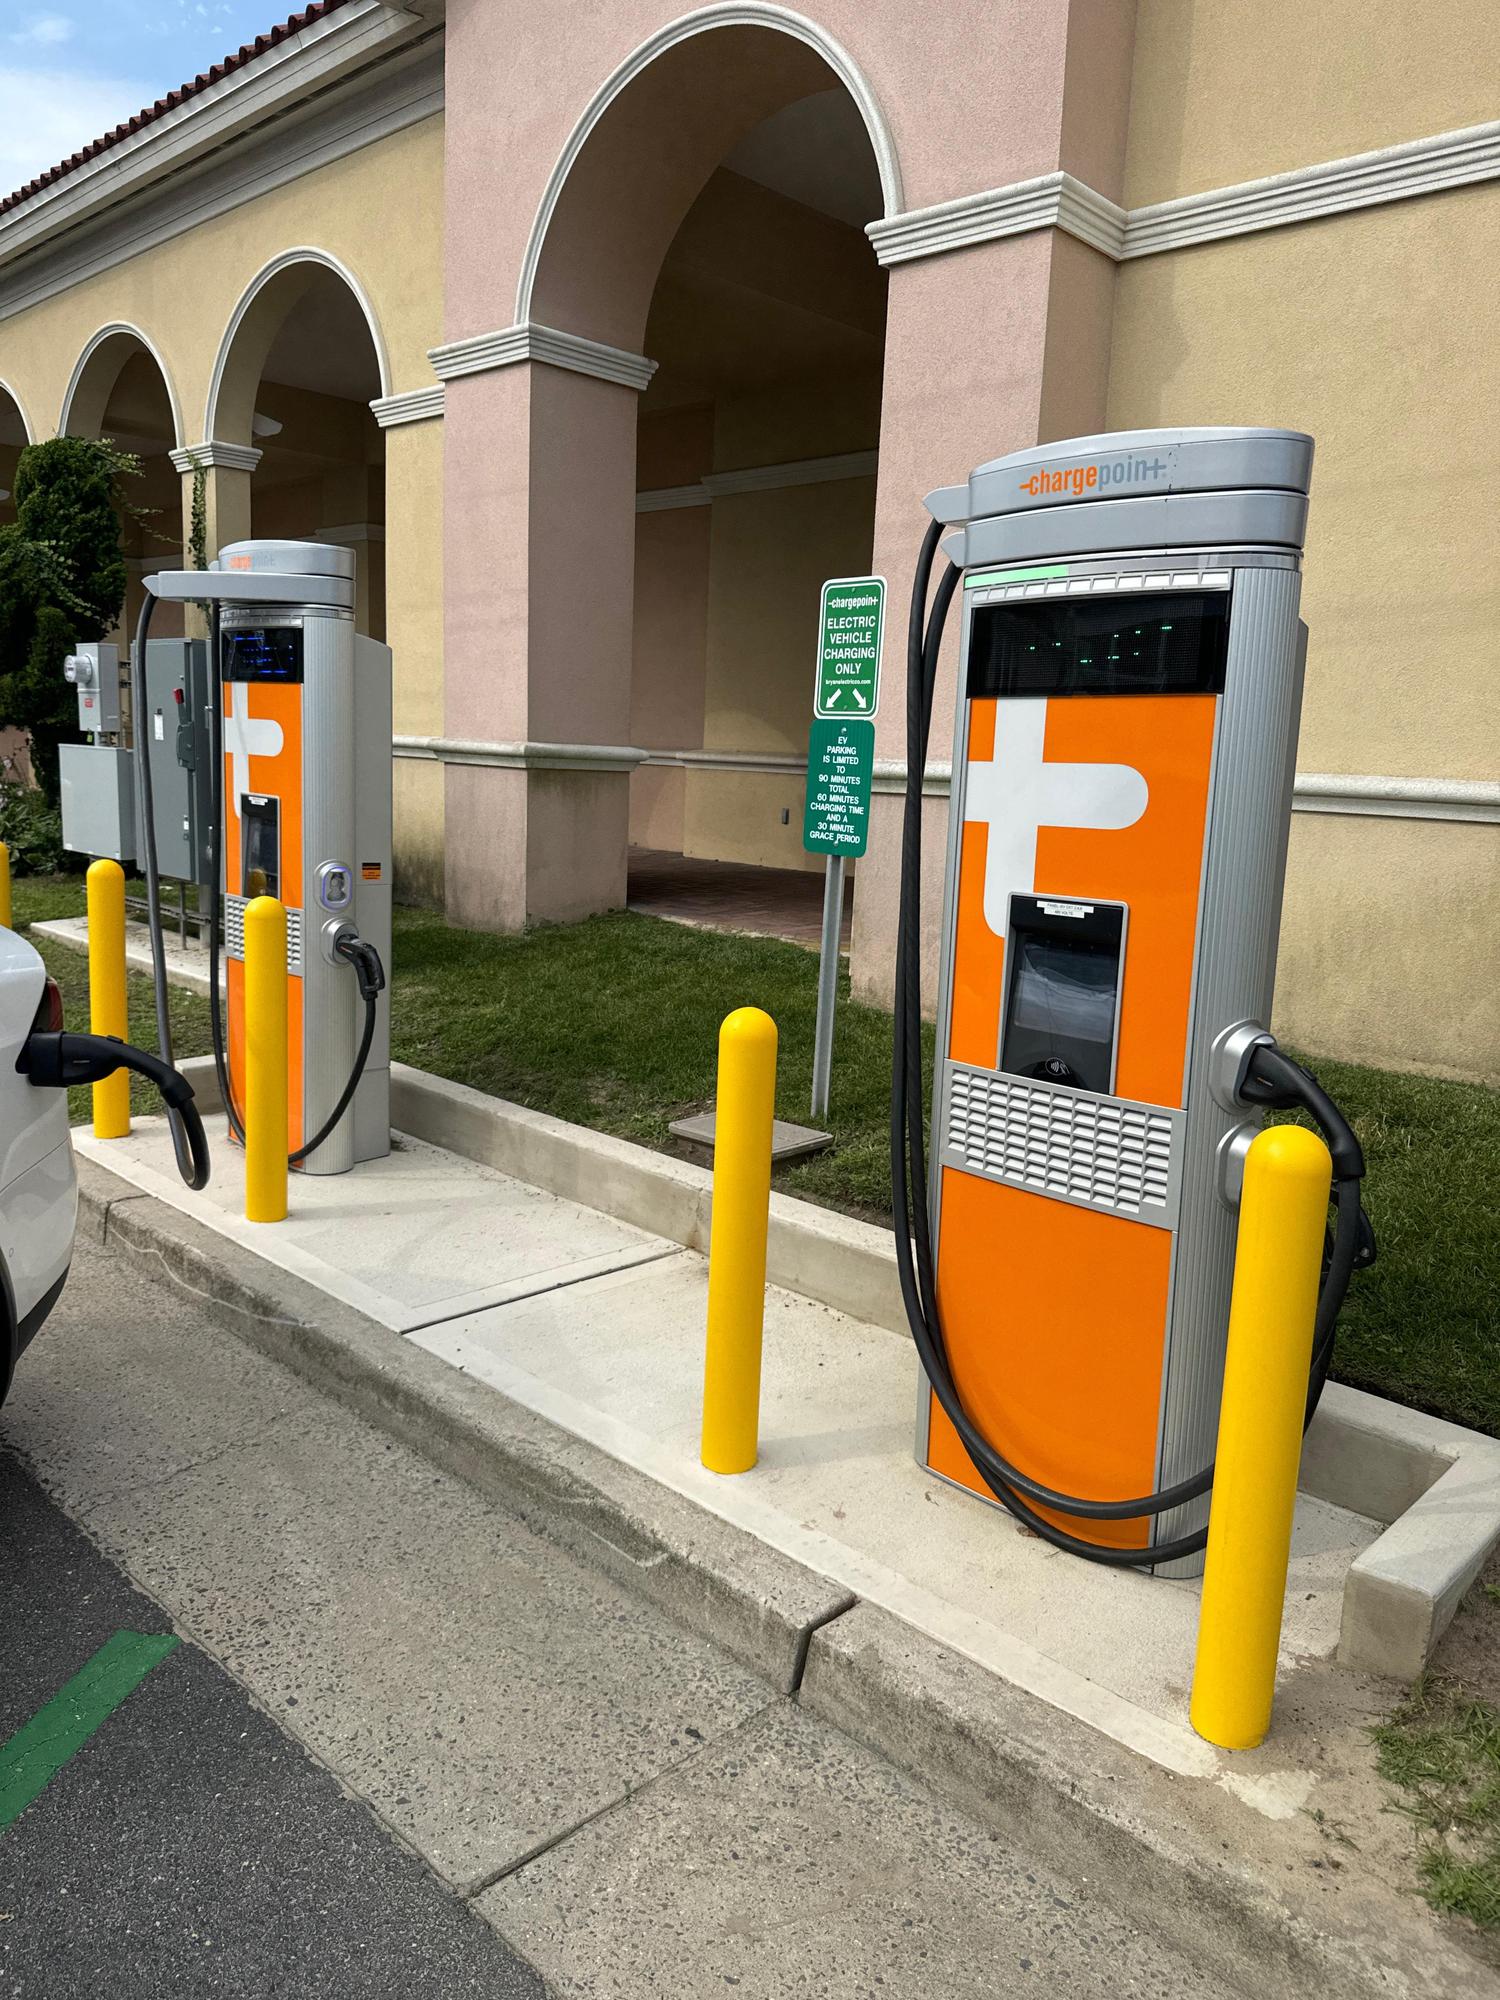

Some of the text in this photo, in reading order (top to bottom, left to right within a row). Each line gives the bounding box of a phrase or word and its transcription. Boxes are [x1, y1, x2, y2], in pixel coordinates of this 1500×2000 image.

[827, 616, 876, 629] ELECTRIC
[830, 632, 872, 644] VEHICLE
[824, 647, 875, 660] CHARGING
[835, 663, 862, 675] ONLY
[837, 736, 848, 744] EV
[826, 745, 857, 755] PARKING
[822, 755, 859, 765] IS LIMITED
[836, 765, 846, 774] TO
[818, 774, 861, 785] 90 MINUTES
[829, 785, 849, 794] TOTAL
[817, 793, 860, 805] 60 MINUTES
[810, 802, 865, 815] CHARGING TIME
[826, 813, 848, 823] AND A
[817, 822, 855, 834] 30 MINUTE
[809, 830, 861, 844] GRACE PERIOD
